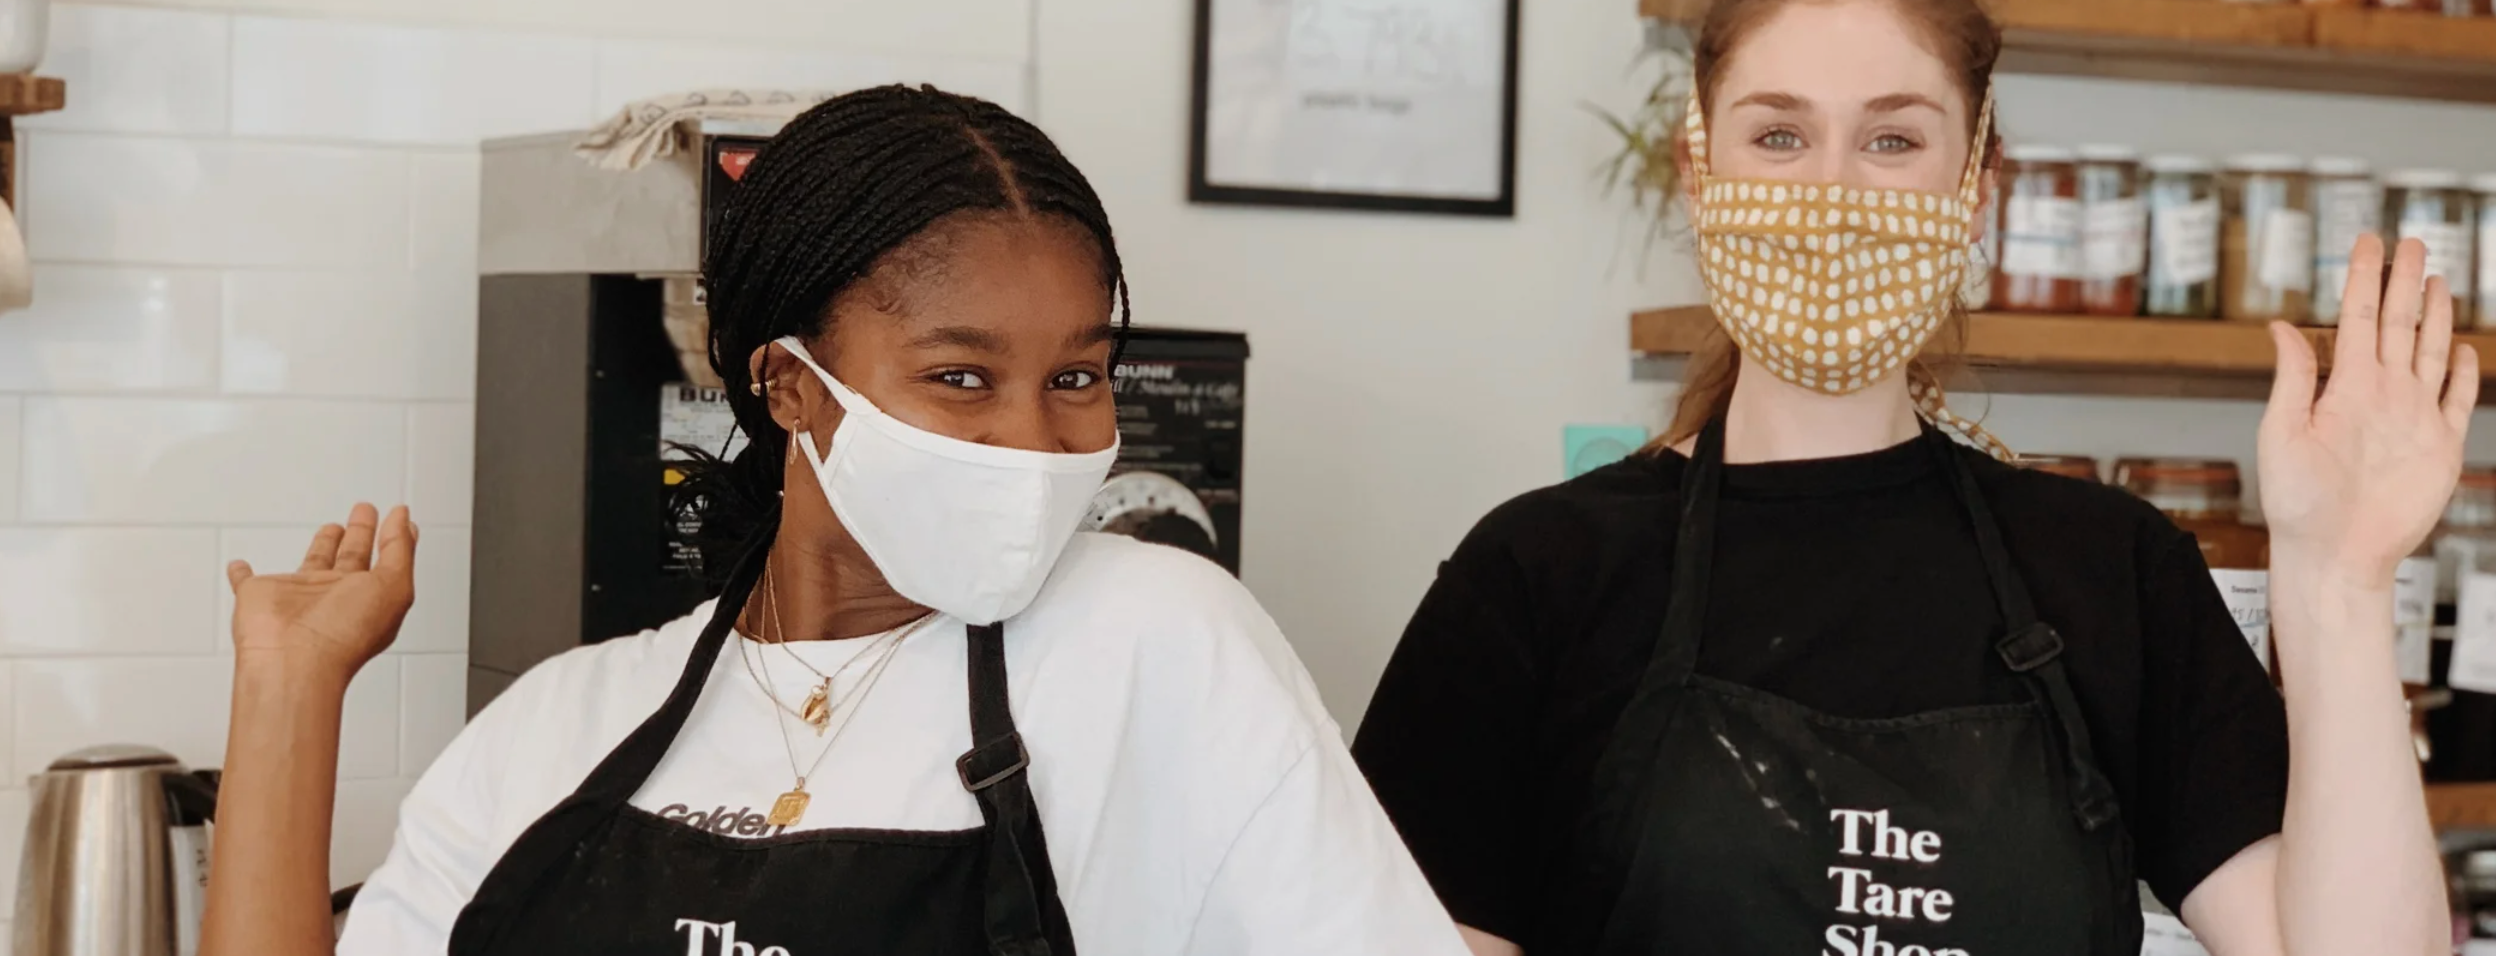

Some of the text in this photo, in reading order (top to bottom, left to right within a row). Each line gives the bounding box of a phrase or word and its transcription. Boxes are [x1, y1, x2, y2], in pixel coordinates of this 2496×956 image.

[1830, 809, 1942, 863] The
[1827, 866, 1954, 922] Tare
[1822, 924, 1971, 956] Sh
